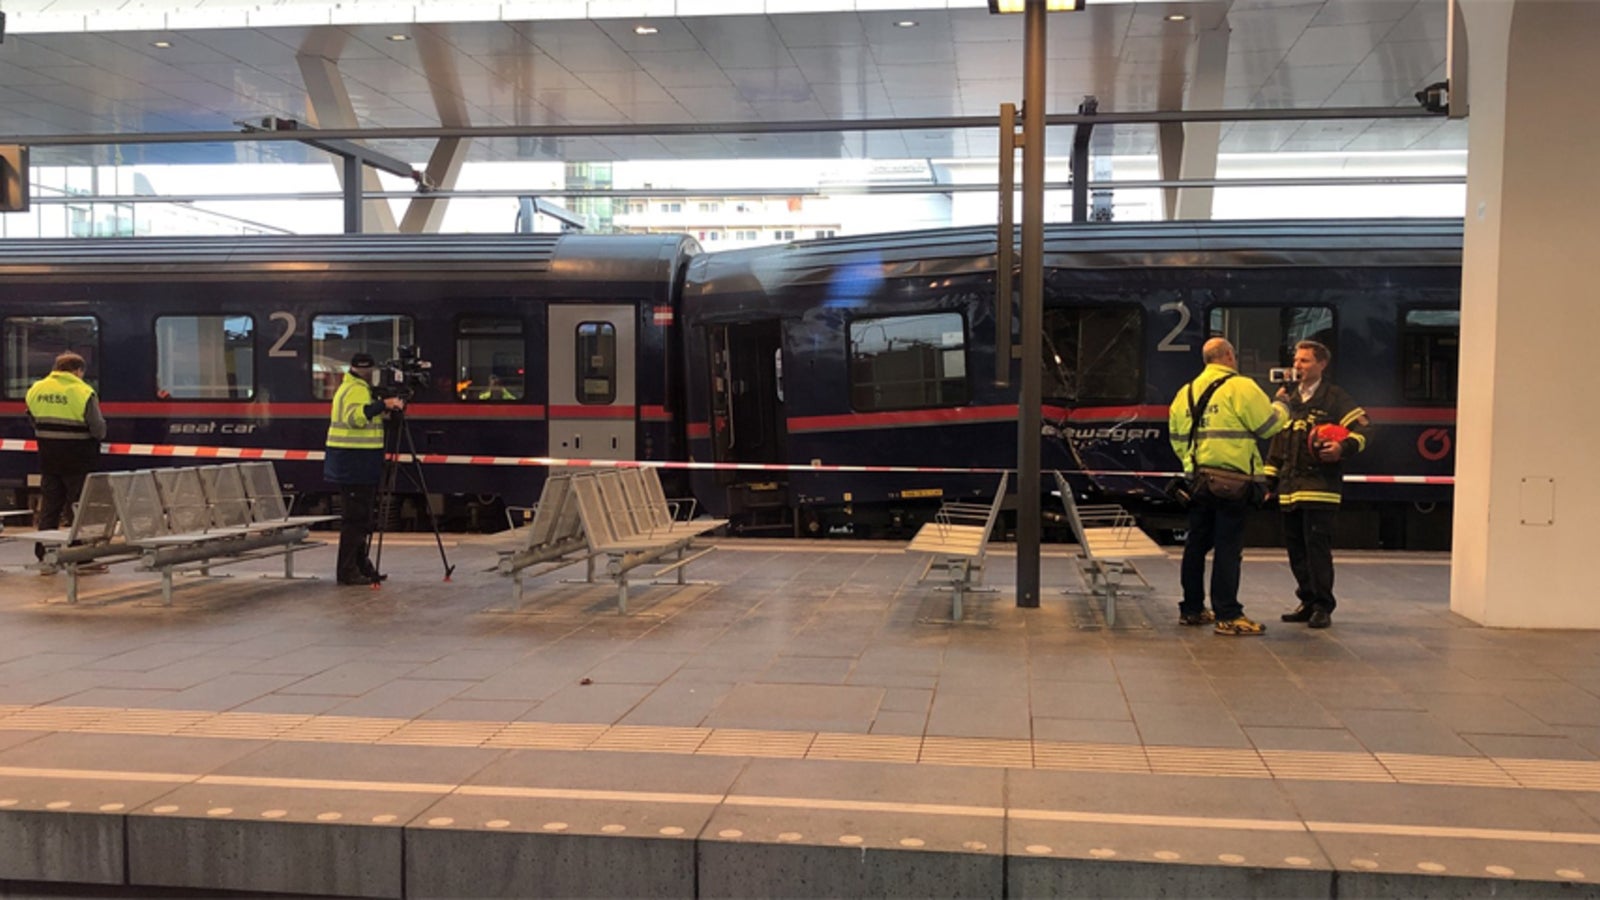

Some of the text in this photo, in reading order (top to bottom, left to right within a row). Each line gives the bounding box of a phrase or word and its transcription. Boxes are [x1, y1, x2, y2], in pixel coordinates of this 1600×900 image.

[268, 311, 298, 357] 2
[1157, 302, 1191, 352] 2
[37, 393, 68, 406] PRESS
[169, 421, 257, 434] seat car
